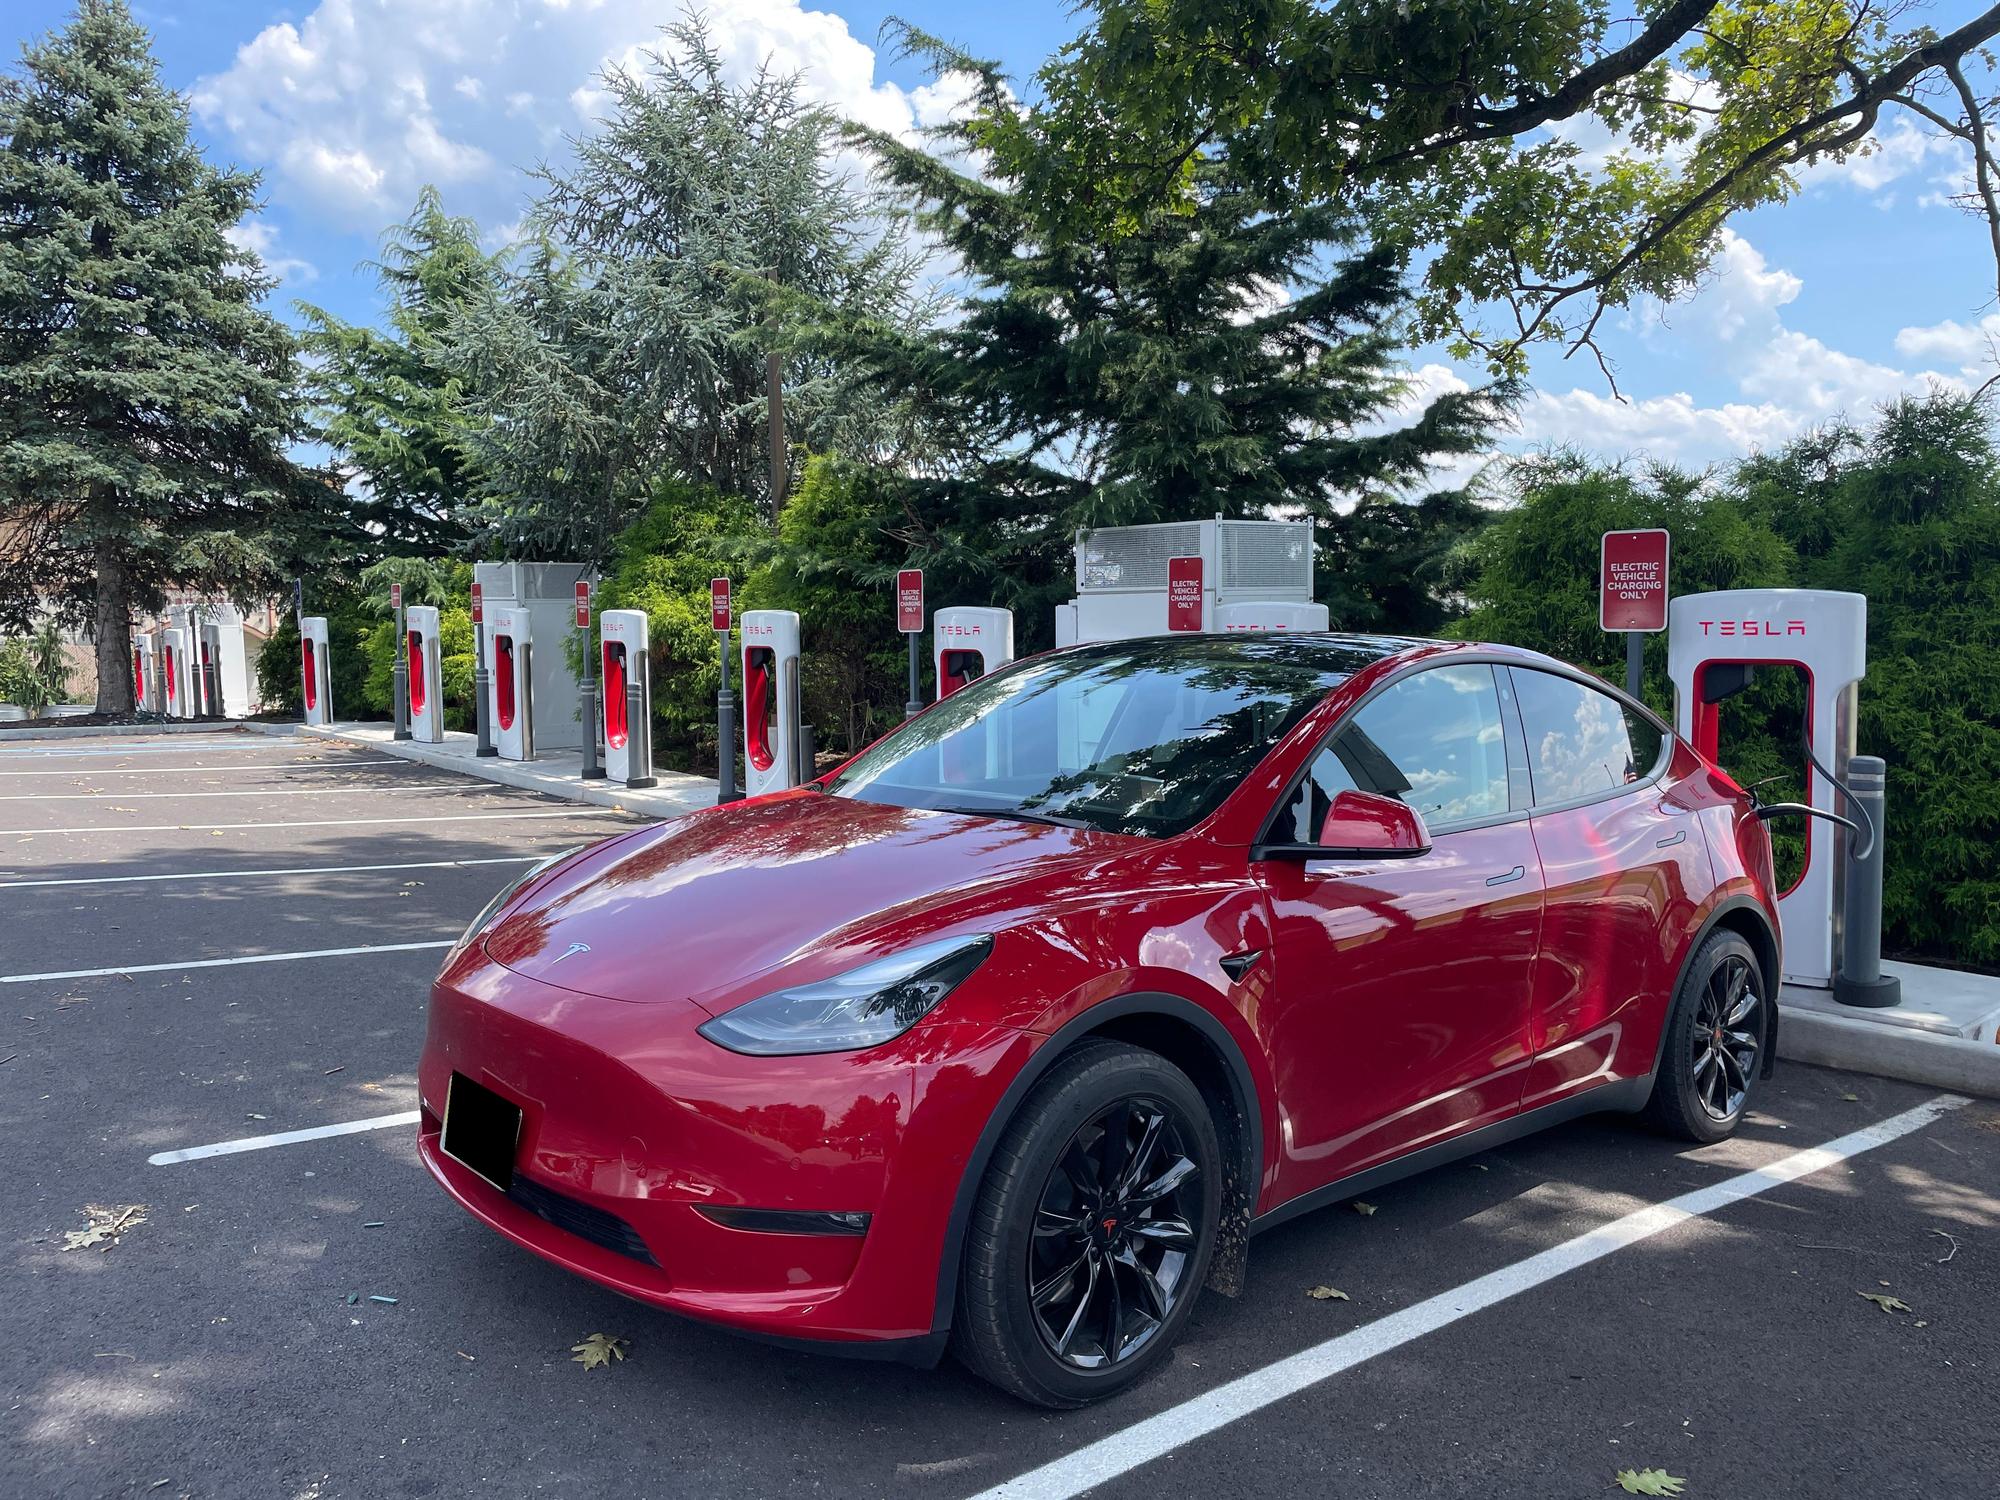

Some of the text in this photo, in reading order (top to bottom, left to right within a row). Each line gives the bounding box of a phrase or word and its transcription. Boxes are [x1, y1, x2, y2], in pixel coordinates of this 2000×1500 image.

[1610, 562, 1659, 571] ELECTRIC
[1614, 572, 1656, 580] VEHICLE
[1607, 581, 1662, 590] CHARGING
[1620, 591, 1648, 600] ONLY
[745, 626, 772, 634] TESLA
[940, 626, 980, 635] TESLA
[1698, 621, 1806, 636] TESLA
